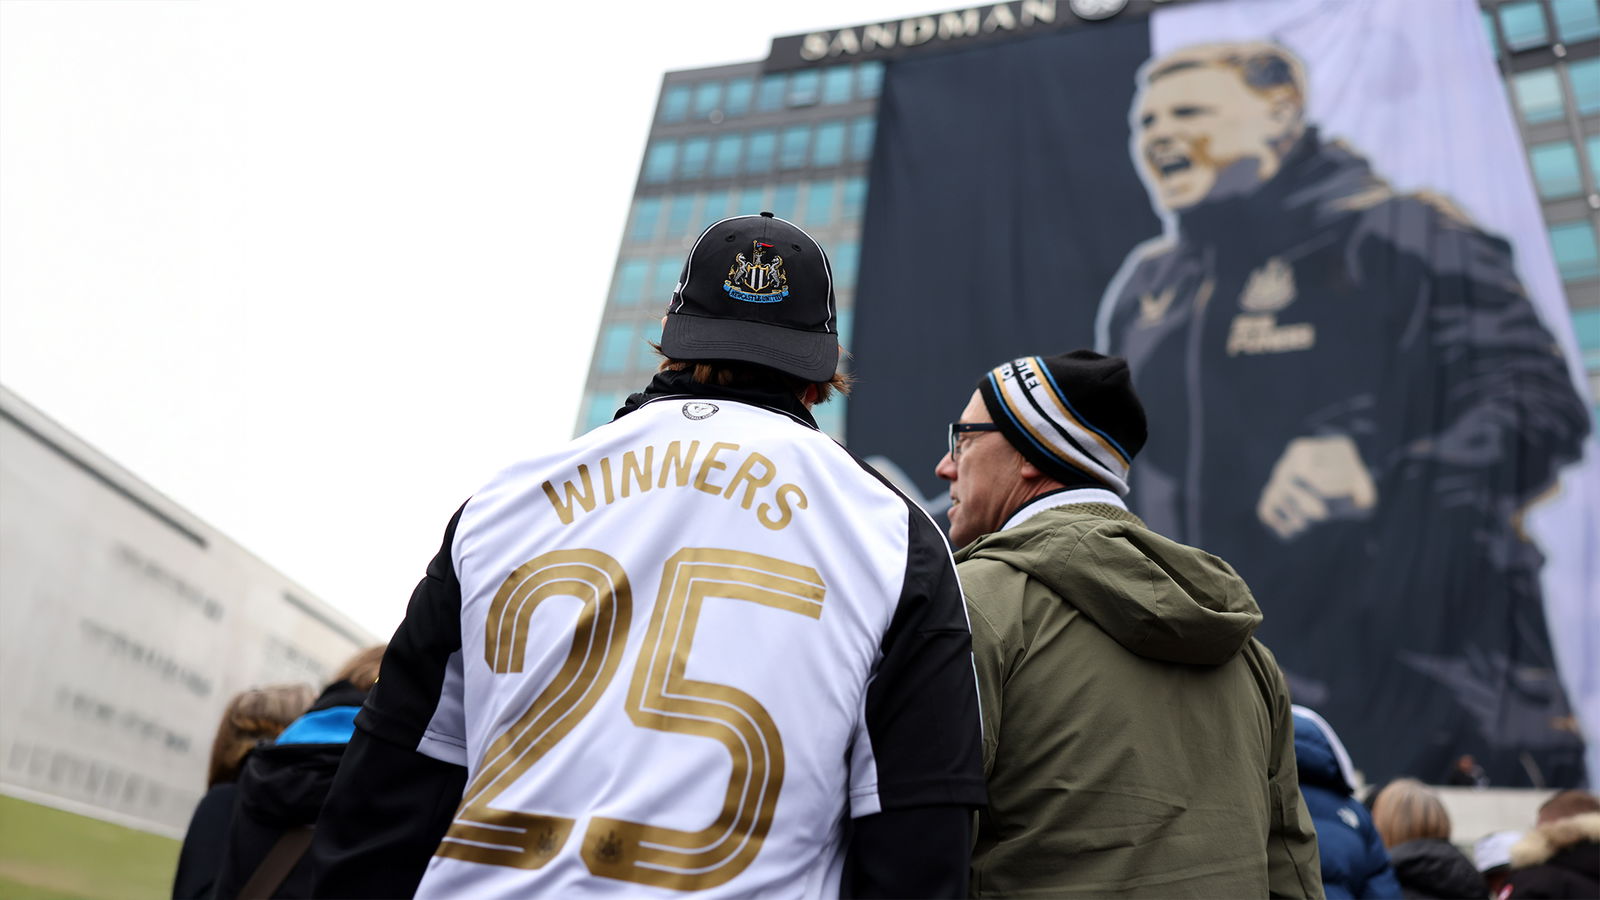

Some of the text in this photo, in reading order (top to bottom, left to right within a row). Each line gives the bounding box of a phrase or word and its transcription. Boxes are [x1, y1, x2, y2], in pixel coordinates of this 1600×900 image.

[800, 0, 1056, 60] SANDMAN
[541, 440, 808, 530] WINNERS
[434, 547, 827, 892] 25
